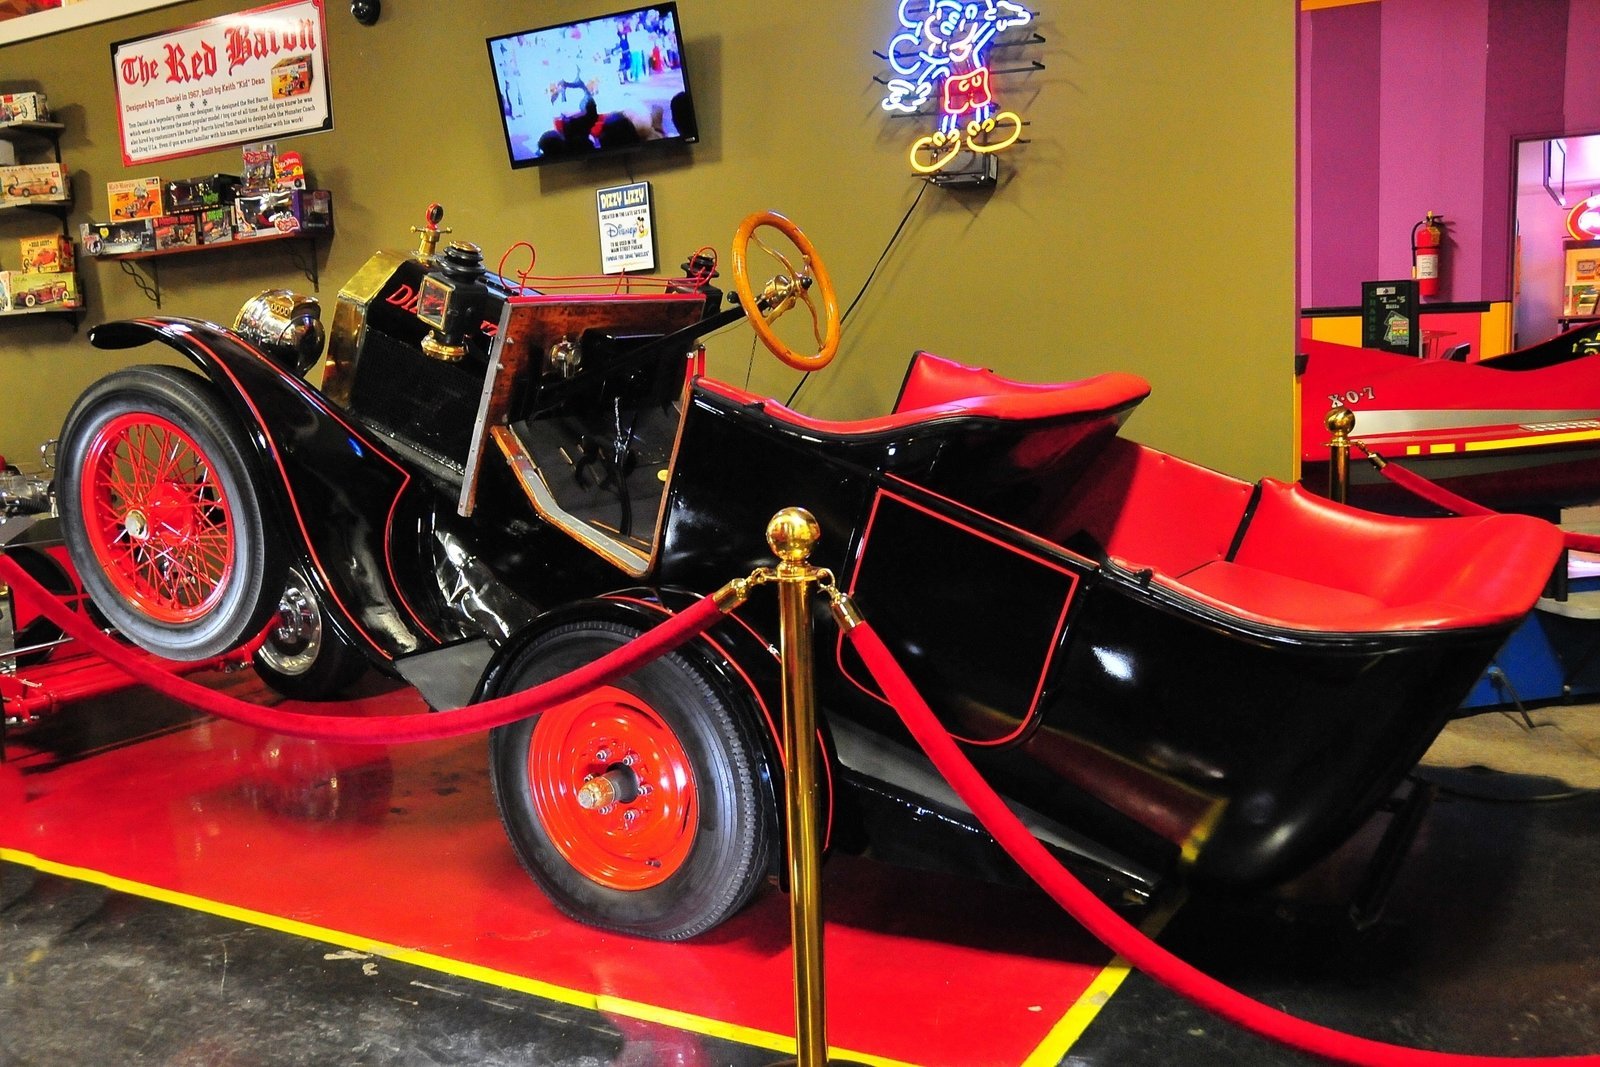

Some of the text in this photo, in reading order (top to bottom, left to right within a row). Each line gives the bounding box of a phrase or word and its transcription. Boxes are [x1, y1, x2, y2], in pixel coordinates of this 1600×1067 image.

[121, 18, 317, 87] The Red Baron
[126, 101, 148, 112] Designed
[148, 100, 154, 108] by
[166, 93, 181, 104] Daniel
[202, 87, 213, 96] built
[214, 85, 221, 94] by
[222, 82, 236, 92] Keith
[236, 79, 250, 88] "Kid"
[252, 78, 265, 86] Dean
[600, 187, 645, 209] DIZZY LIZZY
